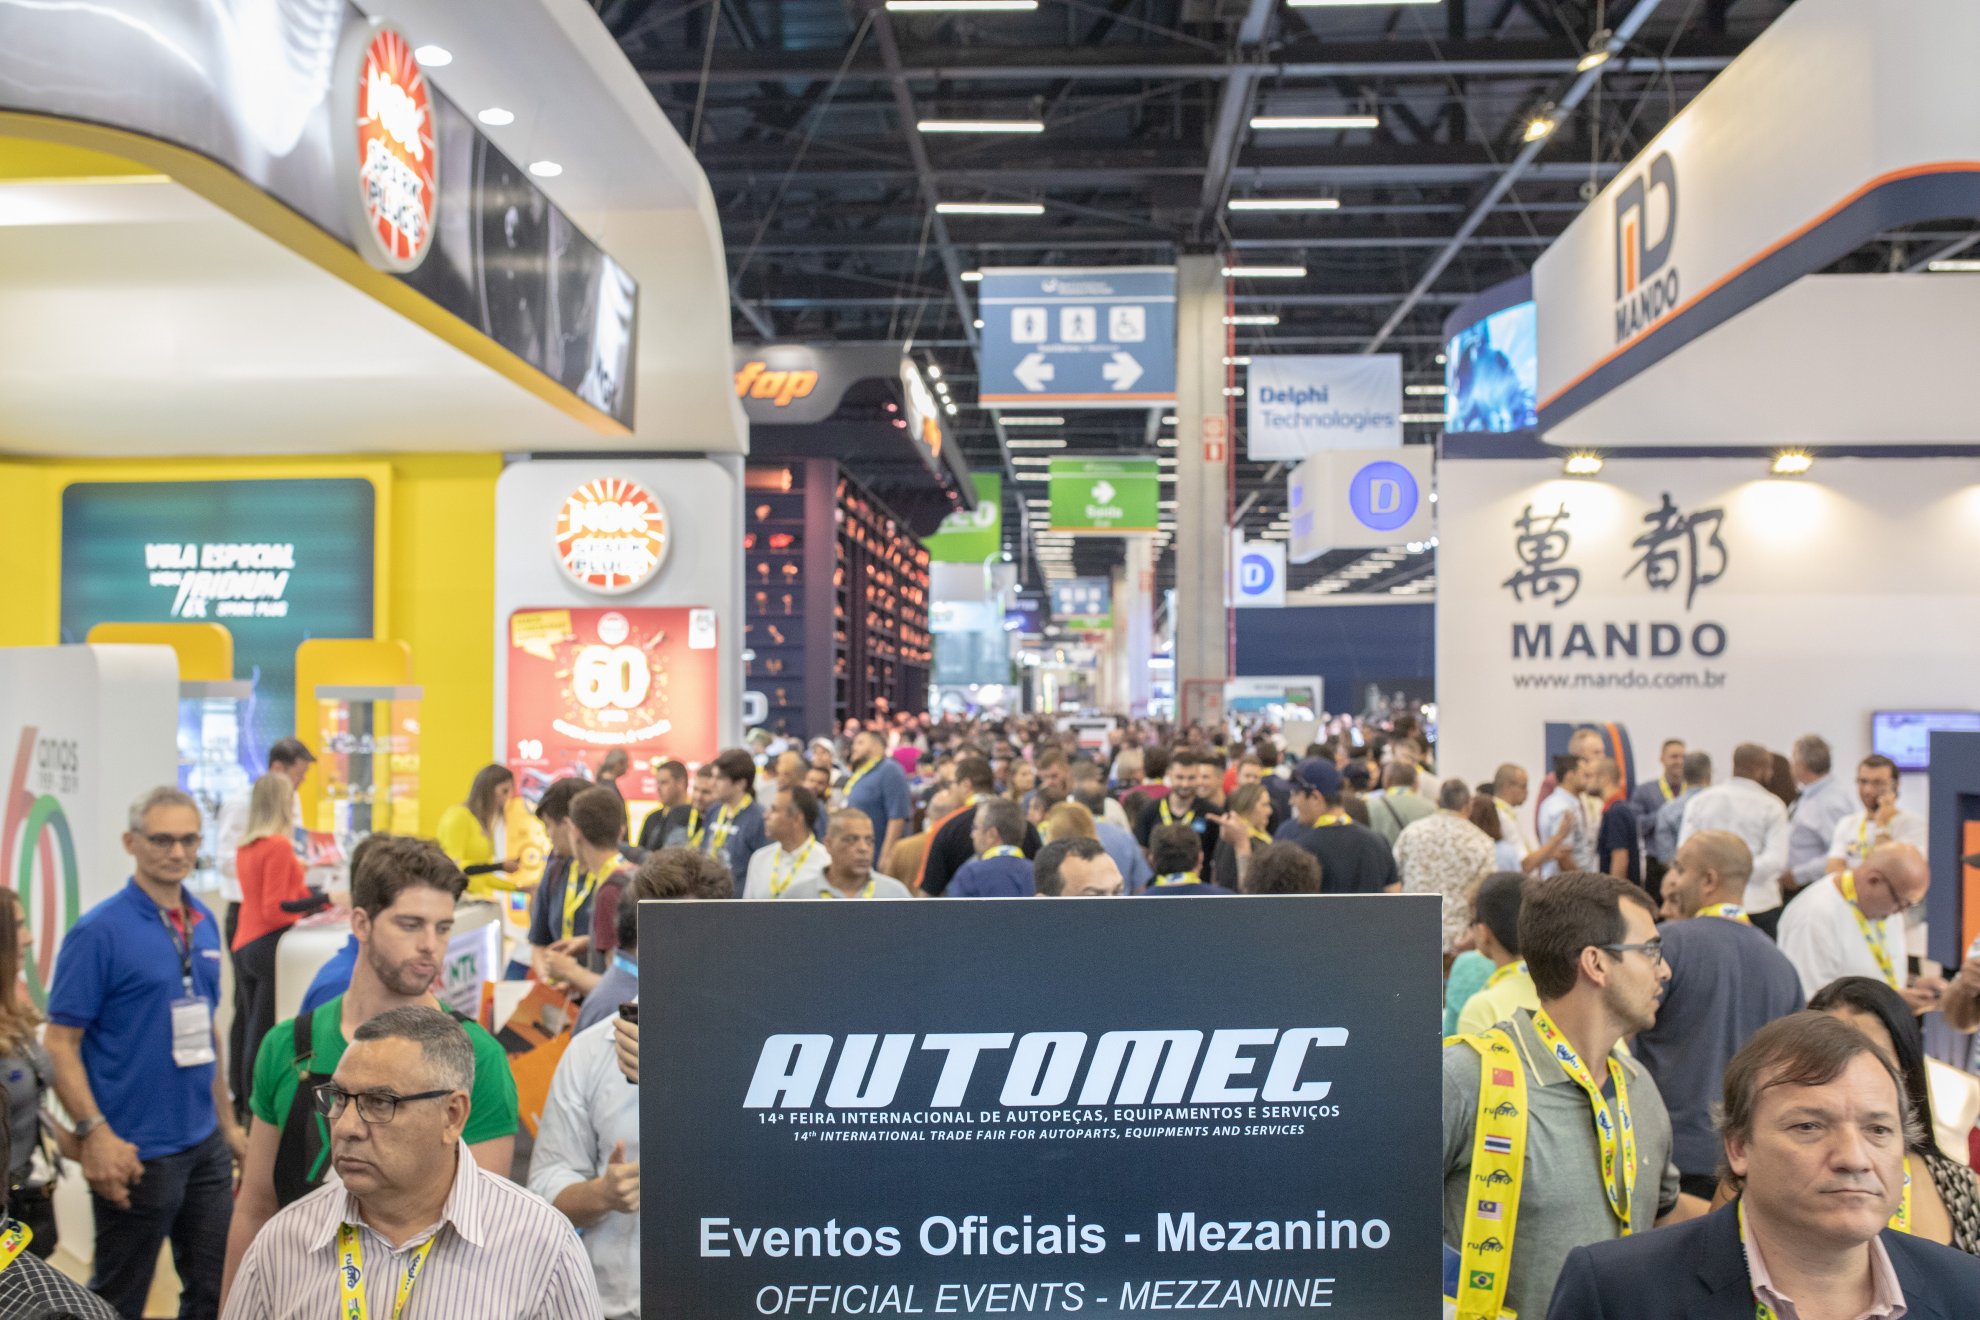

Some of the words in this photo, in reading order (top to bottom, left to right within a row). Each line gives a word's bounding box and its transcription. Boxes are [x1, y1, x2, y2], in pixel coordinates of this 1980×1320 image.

[1616, 267, 1679, 343] MANDO
[1260, 386, 1329, 406] Delphi
[1261, 411, 1395, 432] Technologies
[1370, 479, 1401, 514] D
[1513, 623, 1727, 659] MANDO
[573, 644, 651, 710] 60
[1513, 668, 1726, 689] www.mando.com.br
[743, 1025, 1349, 1108] AUTOMEC
[790, 1112, 836, 1124] FEIRA
[841, 1111, 972, 1124] INTERNACIONAL
[980, 1111, 1000, 1123] DE
[1006, 1109, 1108, 1125] AUTOPEÇAS,
[1114, 1107, 1243, 1122] EQUIPAMENTOS
[1249, 1107, 1257, 1119] E
[1262, 1105, 1340, 1121] SERVIÇOS
[820, 1130, 926, 1142] INTERNATIONAL
[930, 1130, 973, 1141] TRADE
[976, 1130, 1006, 1140] FAIR
[1009, 1129, 1036, 1140] FOR
[1039, 1128, 1121, 1140] AUTOPARTS,
[1125, 1126, 1209, 1139] EQUIPMENTS
[1212, 1126, 1241, 1137] AND
[1244, 1124, 1305, 1136] SERVICES
[701, 1217, 902, 1258] Eventos
[919, 1214, 1106, 1256] Oficiais
[1157, 1210, 1391, 1252] Mezanino
[756, 1284, 924, 1315] OFFICIAL
[935, 1282, 1085, 1313] EVENTS
[1119, 1278, 1336, 1311] MEZZANINE
